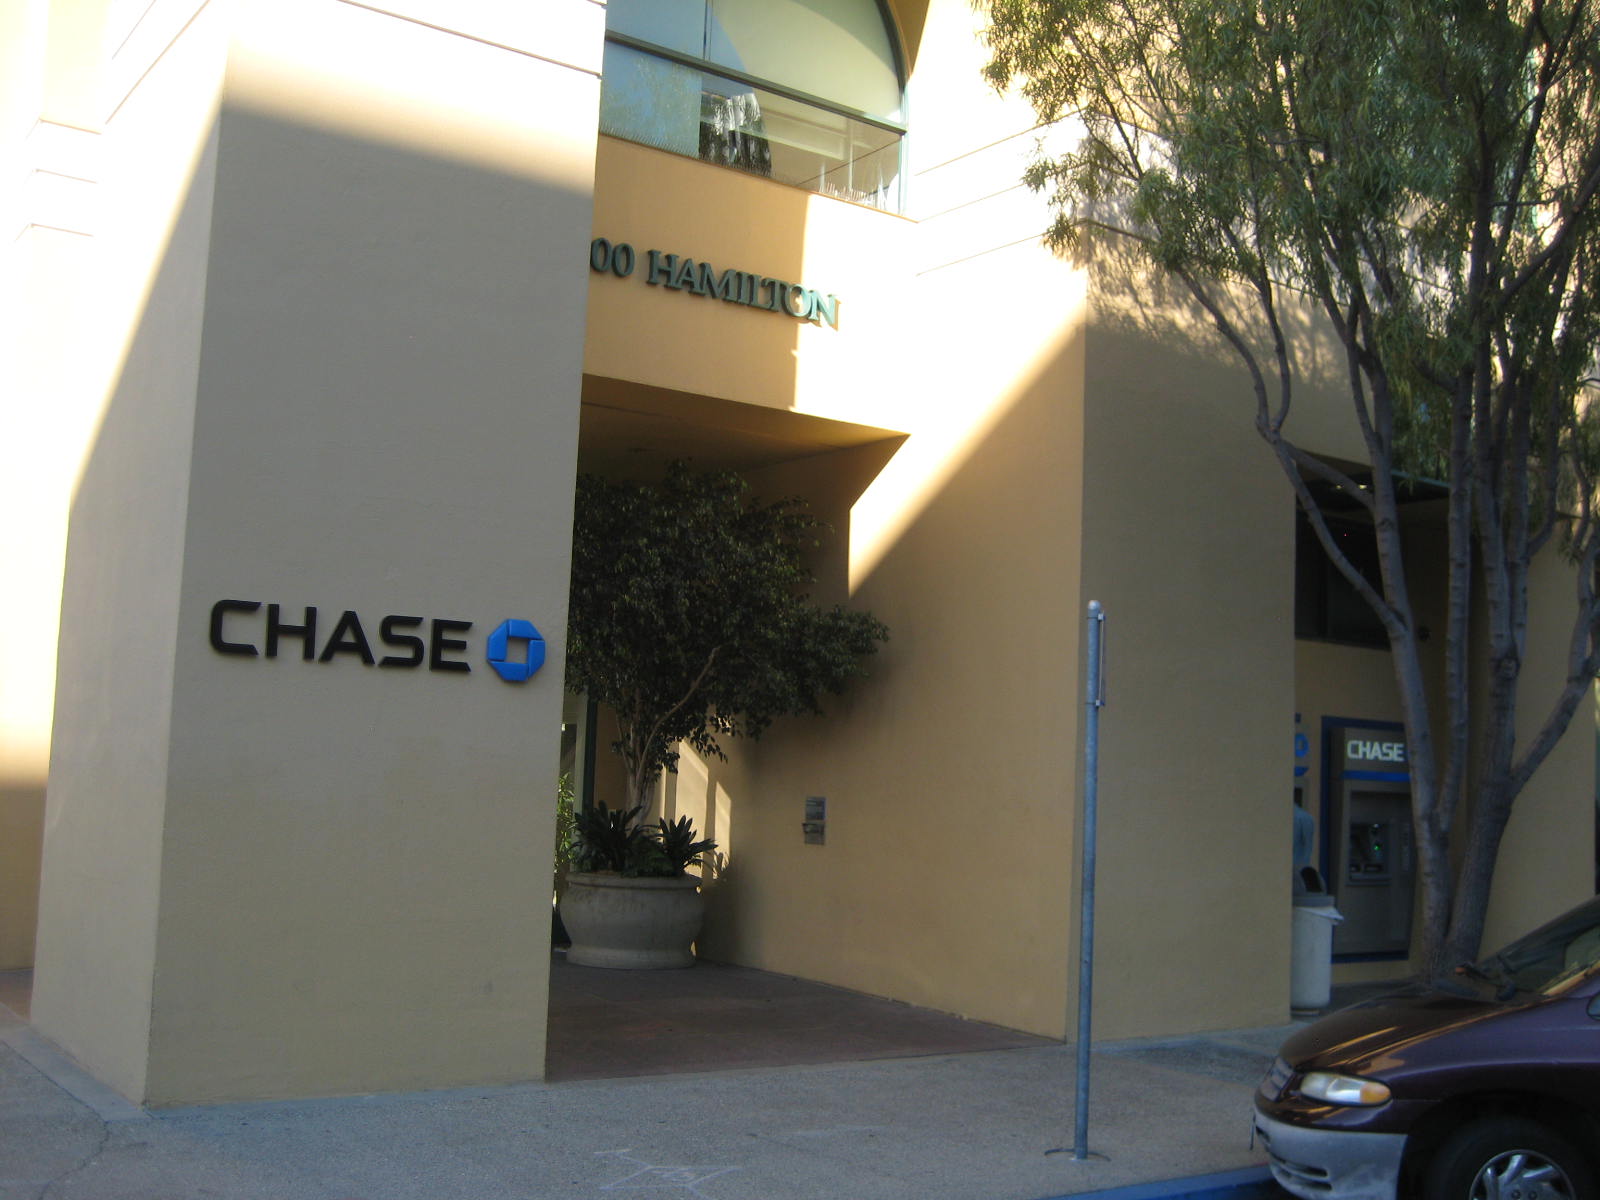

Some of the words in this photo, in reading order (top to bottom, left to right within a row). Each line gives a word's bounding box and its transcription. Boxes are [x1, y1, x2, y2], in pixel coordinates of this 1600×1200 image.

[646, 249, 837, 327] HAMILTON
[210, 599, 473, 673] CHASE
[1347, 740, 1405, 762] CHASE
